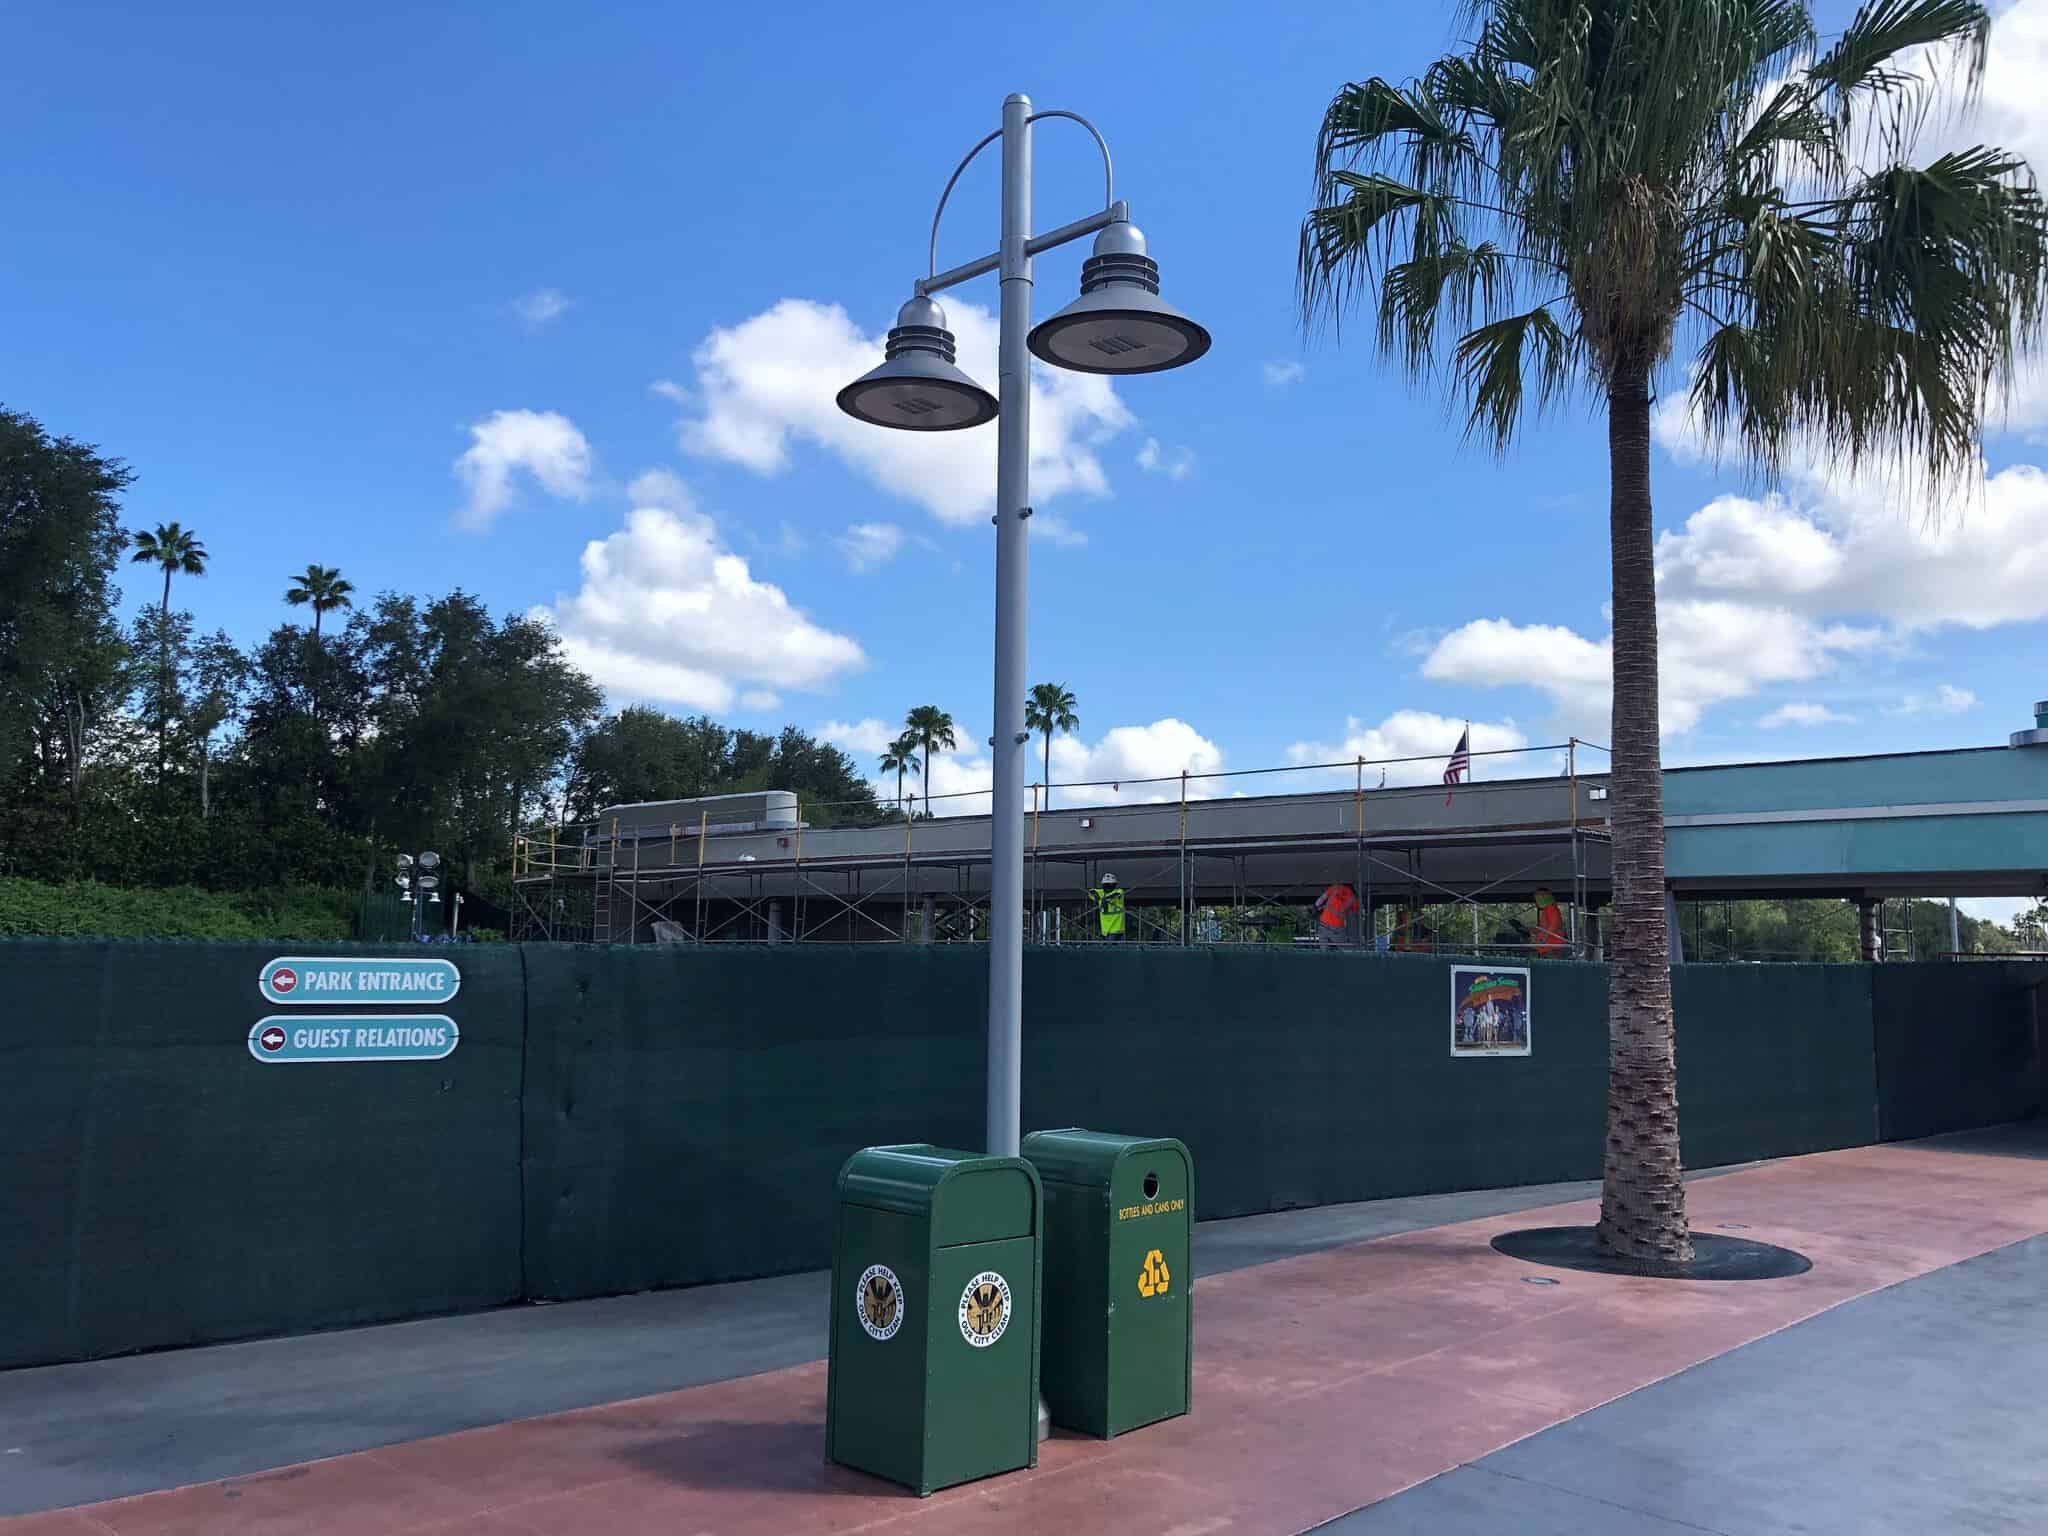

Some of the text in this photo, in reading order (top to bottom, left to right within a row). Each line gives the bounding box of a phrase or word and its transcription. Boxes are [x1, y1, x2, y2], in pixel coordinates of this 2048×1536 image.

[304, 971, 445, 991] PARK ENTRANCE
[293, 1027, 446, 1048] GUEST RELATIONS
[1119, 1199, 1184, 1220] BOTTLES AND CANS ONLY
[859, 1267, 903, 1305] PLEASE HELP KEEP
[961, 1274, 1010, 1309] PLEASE HELP KEEP
[859, 1304, 901, 1337] OUR CITY CLEAN
[961, 1313, 1009, 1345] OUR CITY CLEAN
